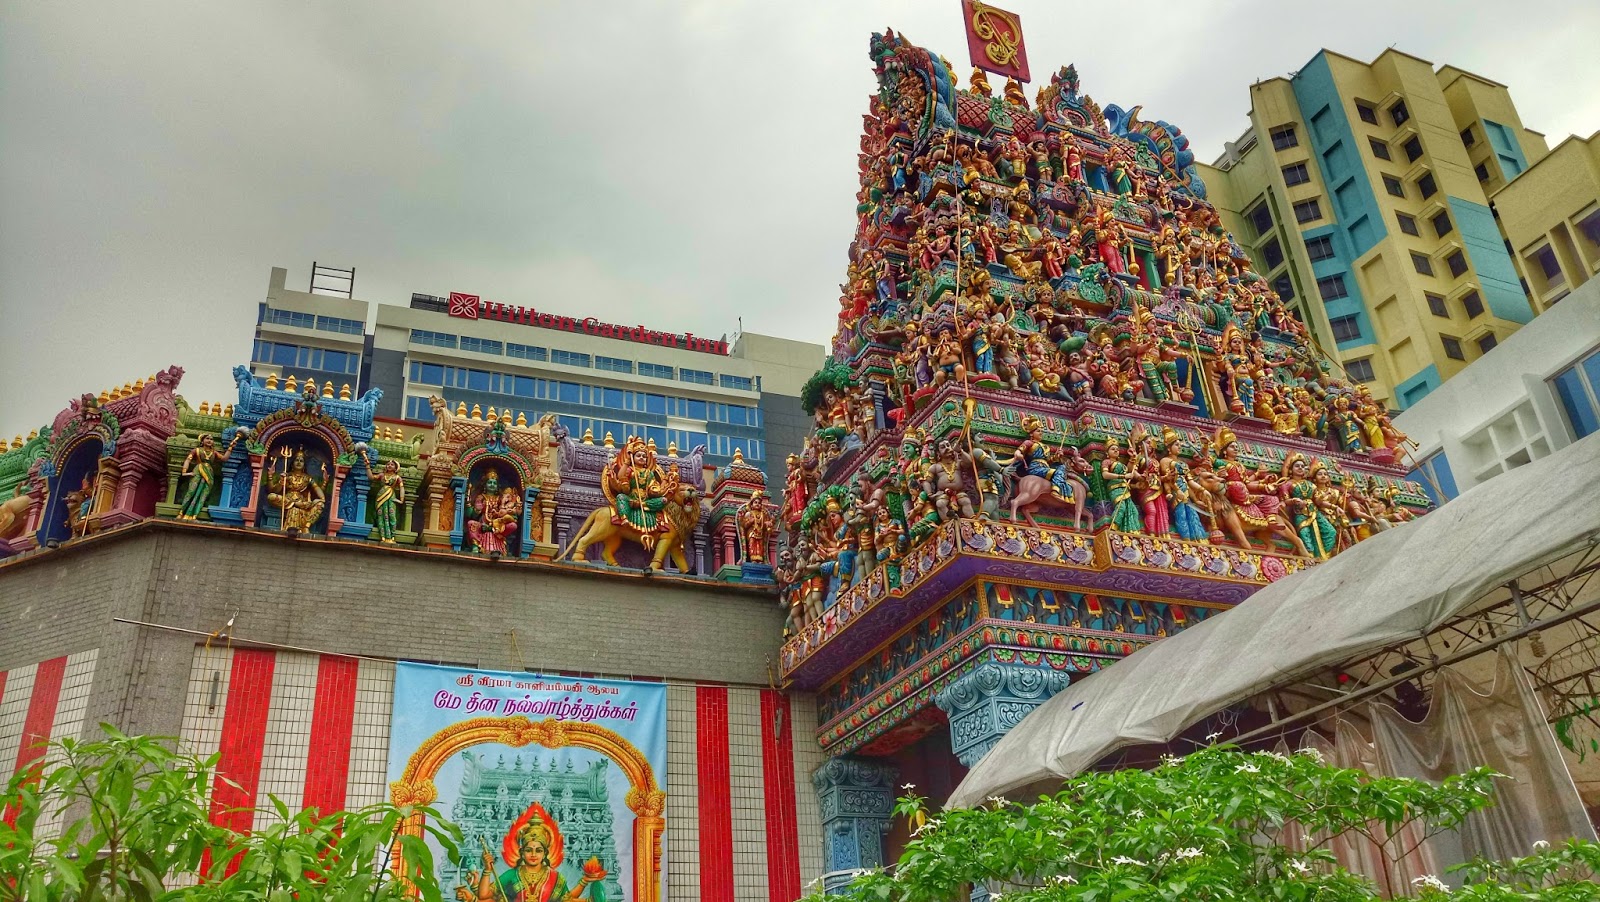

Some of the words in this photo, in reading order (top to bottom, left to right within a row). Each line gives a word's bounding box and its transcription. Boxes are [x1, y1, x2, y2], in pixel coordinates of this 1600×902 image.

[484, 300, 575, 332] Hilton
[582, 317, 678, 350] Garden
[685, 332, 730, 356] Inn
[515, 681, 583, 693] காளியம்மன்
[587, 684, 619, 696] ஆலய
[434, 690, 462, 710] மே
[463, 691, 501, 714] தின
[503, 694, 639, 723] நல்வாழ்த்துக்கள்
